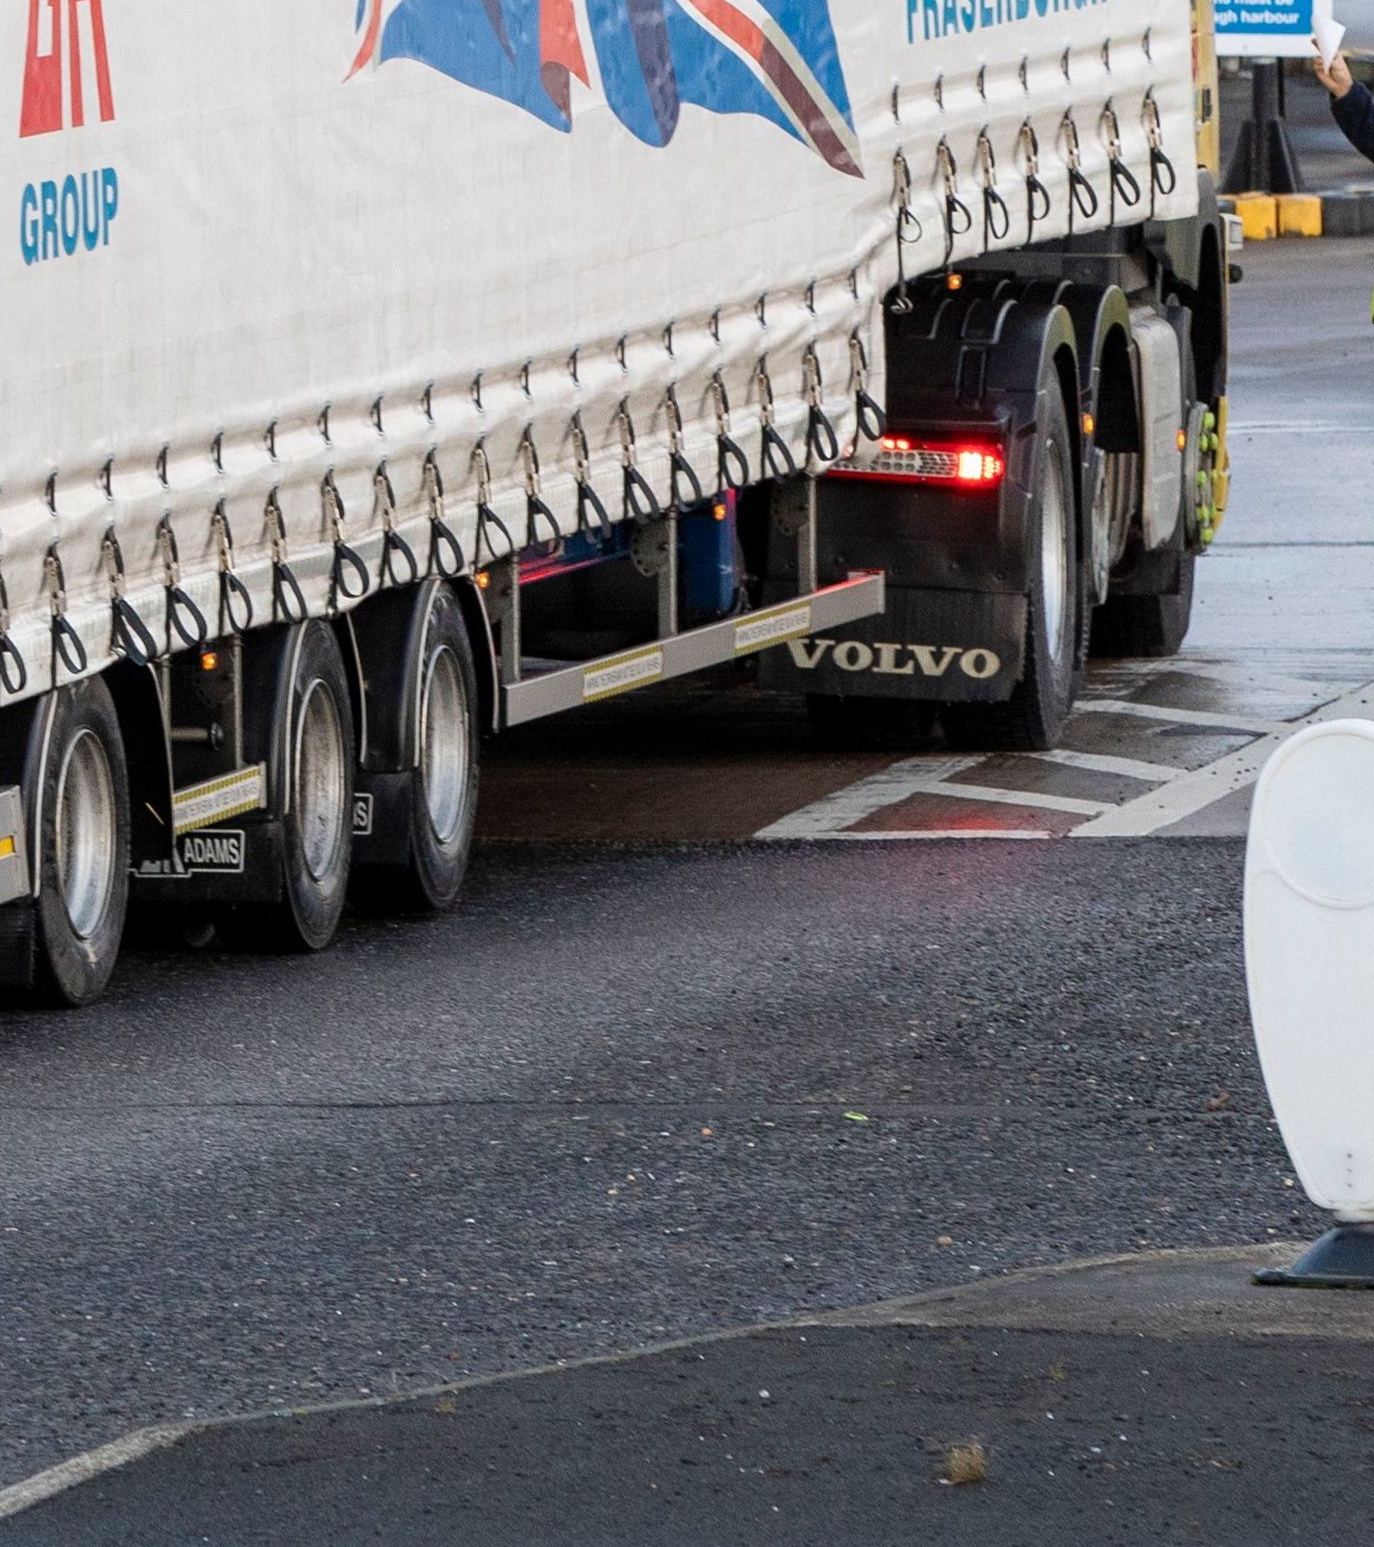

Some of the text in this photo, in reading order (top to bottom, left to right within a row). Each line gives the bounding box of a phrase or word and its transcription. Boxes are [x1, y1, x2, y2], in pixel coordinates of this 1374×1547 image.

[1240, 10, 1300, 24] harbour
[19, 165, 119, 267] GROUP
[786, 638, 1001, 679] VOLVO
[183, 836, 241, 865] ADAMS
